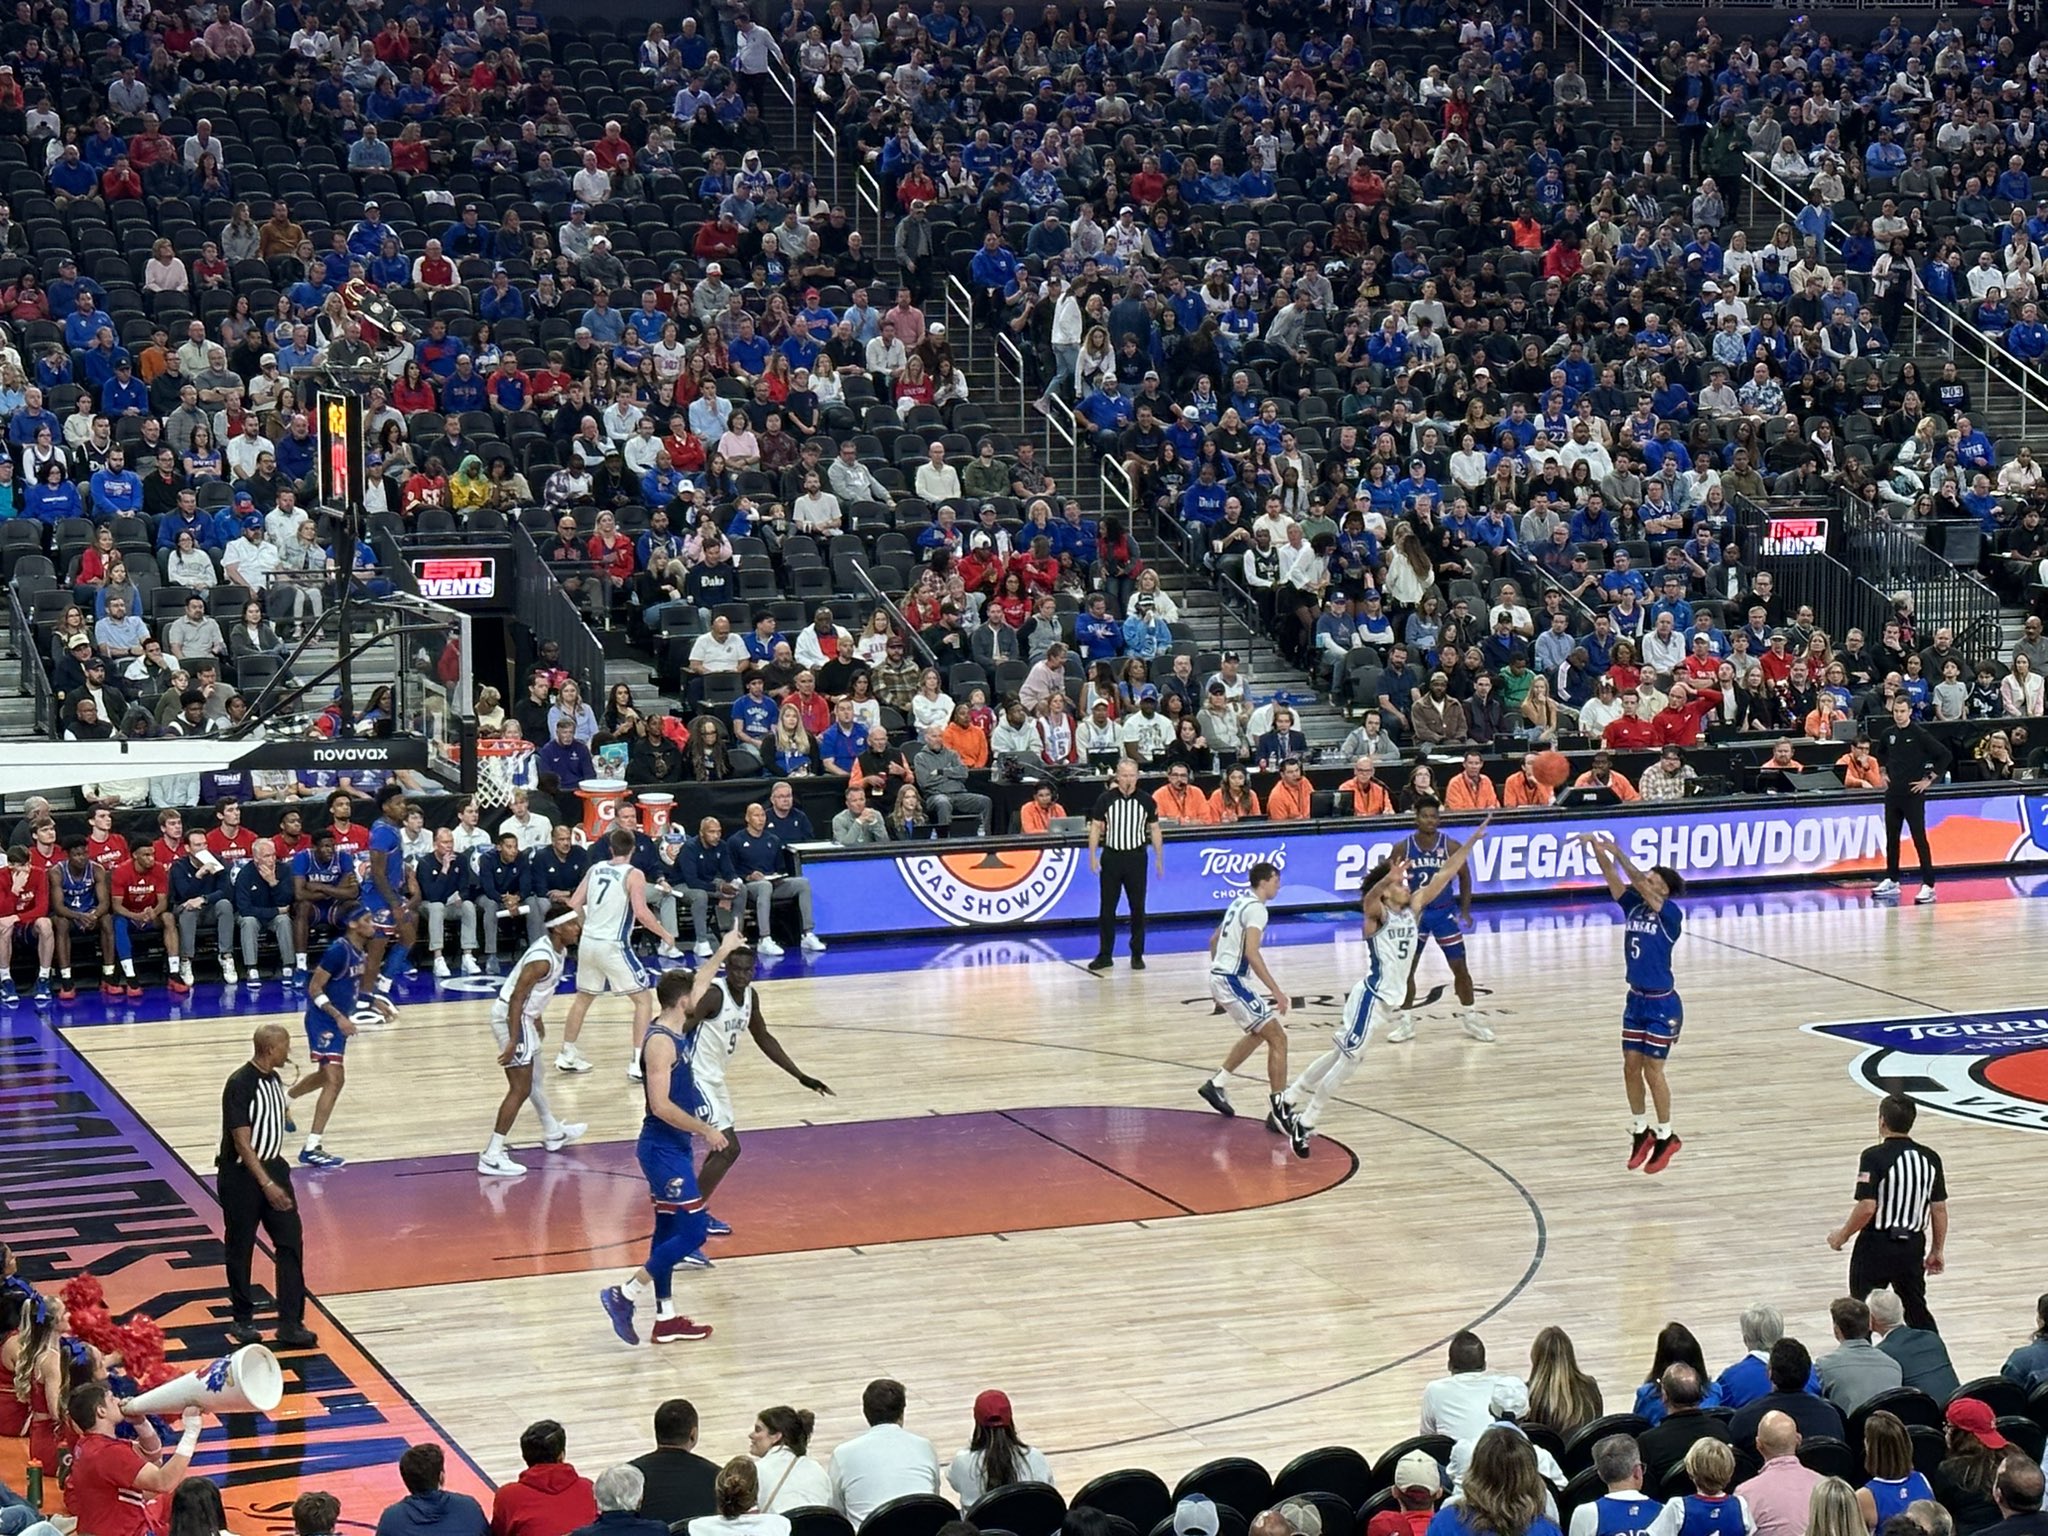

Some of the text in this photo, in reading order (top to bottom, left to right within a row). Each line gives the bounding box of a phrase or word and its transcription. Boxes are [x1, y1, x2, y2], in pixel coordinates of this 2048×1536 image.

[2020, 12, 2029, 22] 3
[1550, 431, 1566, 442] 22
[422, 561, 483, 579] ESPN
[417, 577, 493, 597] EVENTS
[701, 575, 727, 588] Duke
[313, 748, 388, 762] novavax
[1057, 741, 1067, 758] 5
[597, 799, 615, 823] G
[652, 810, 668, 826] G
[1473, 815, 1888, 882] VEGAS SHOWDOWN
[597, 878, 612, 906] 7
[71, 896, 84, 909] 4
[1397, 940, 1411, 960] 5
[1630, 936, 1642, 960] 5
[726, 1032, 738, 1056] 9
[1952, 1096, 2048, 1123] VE
